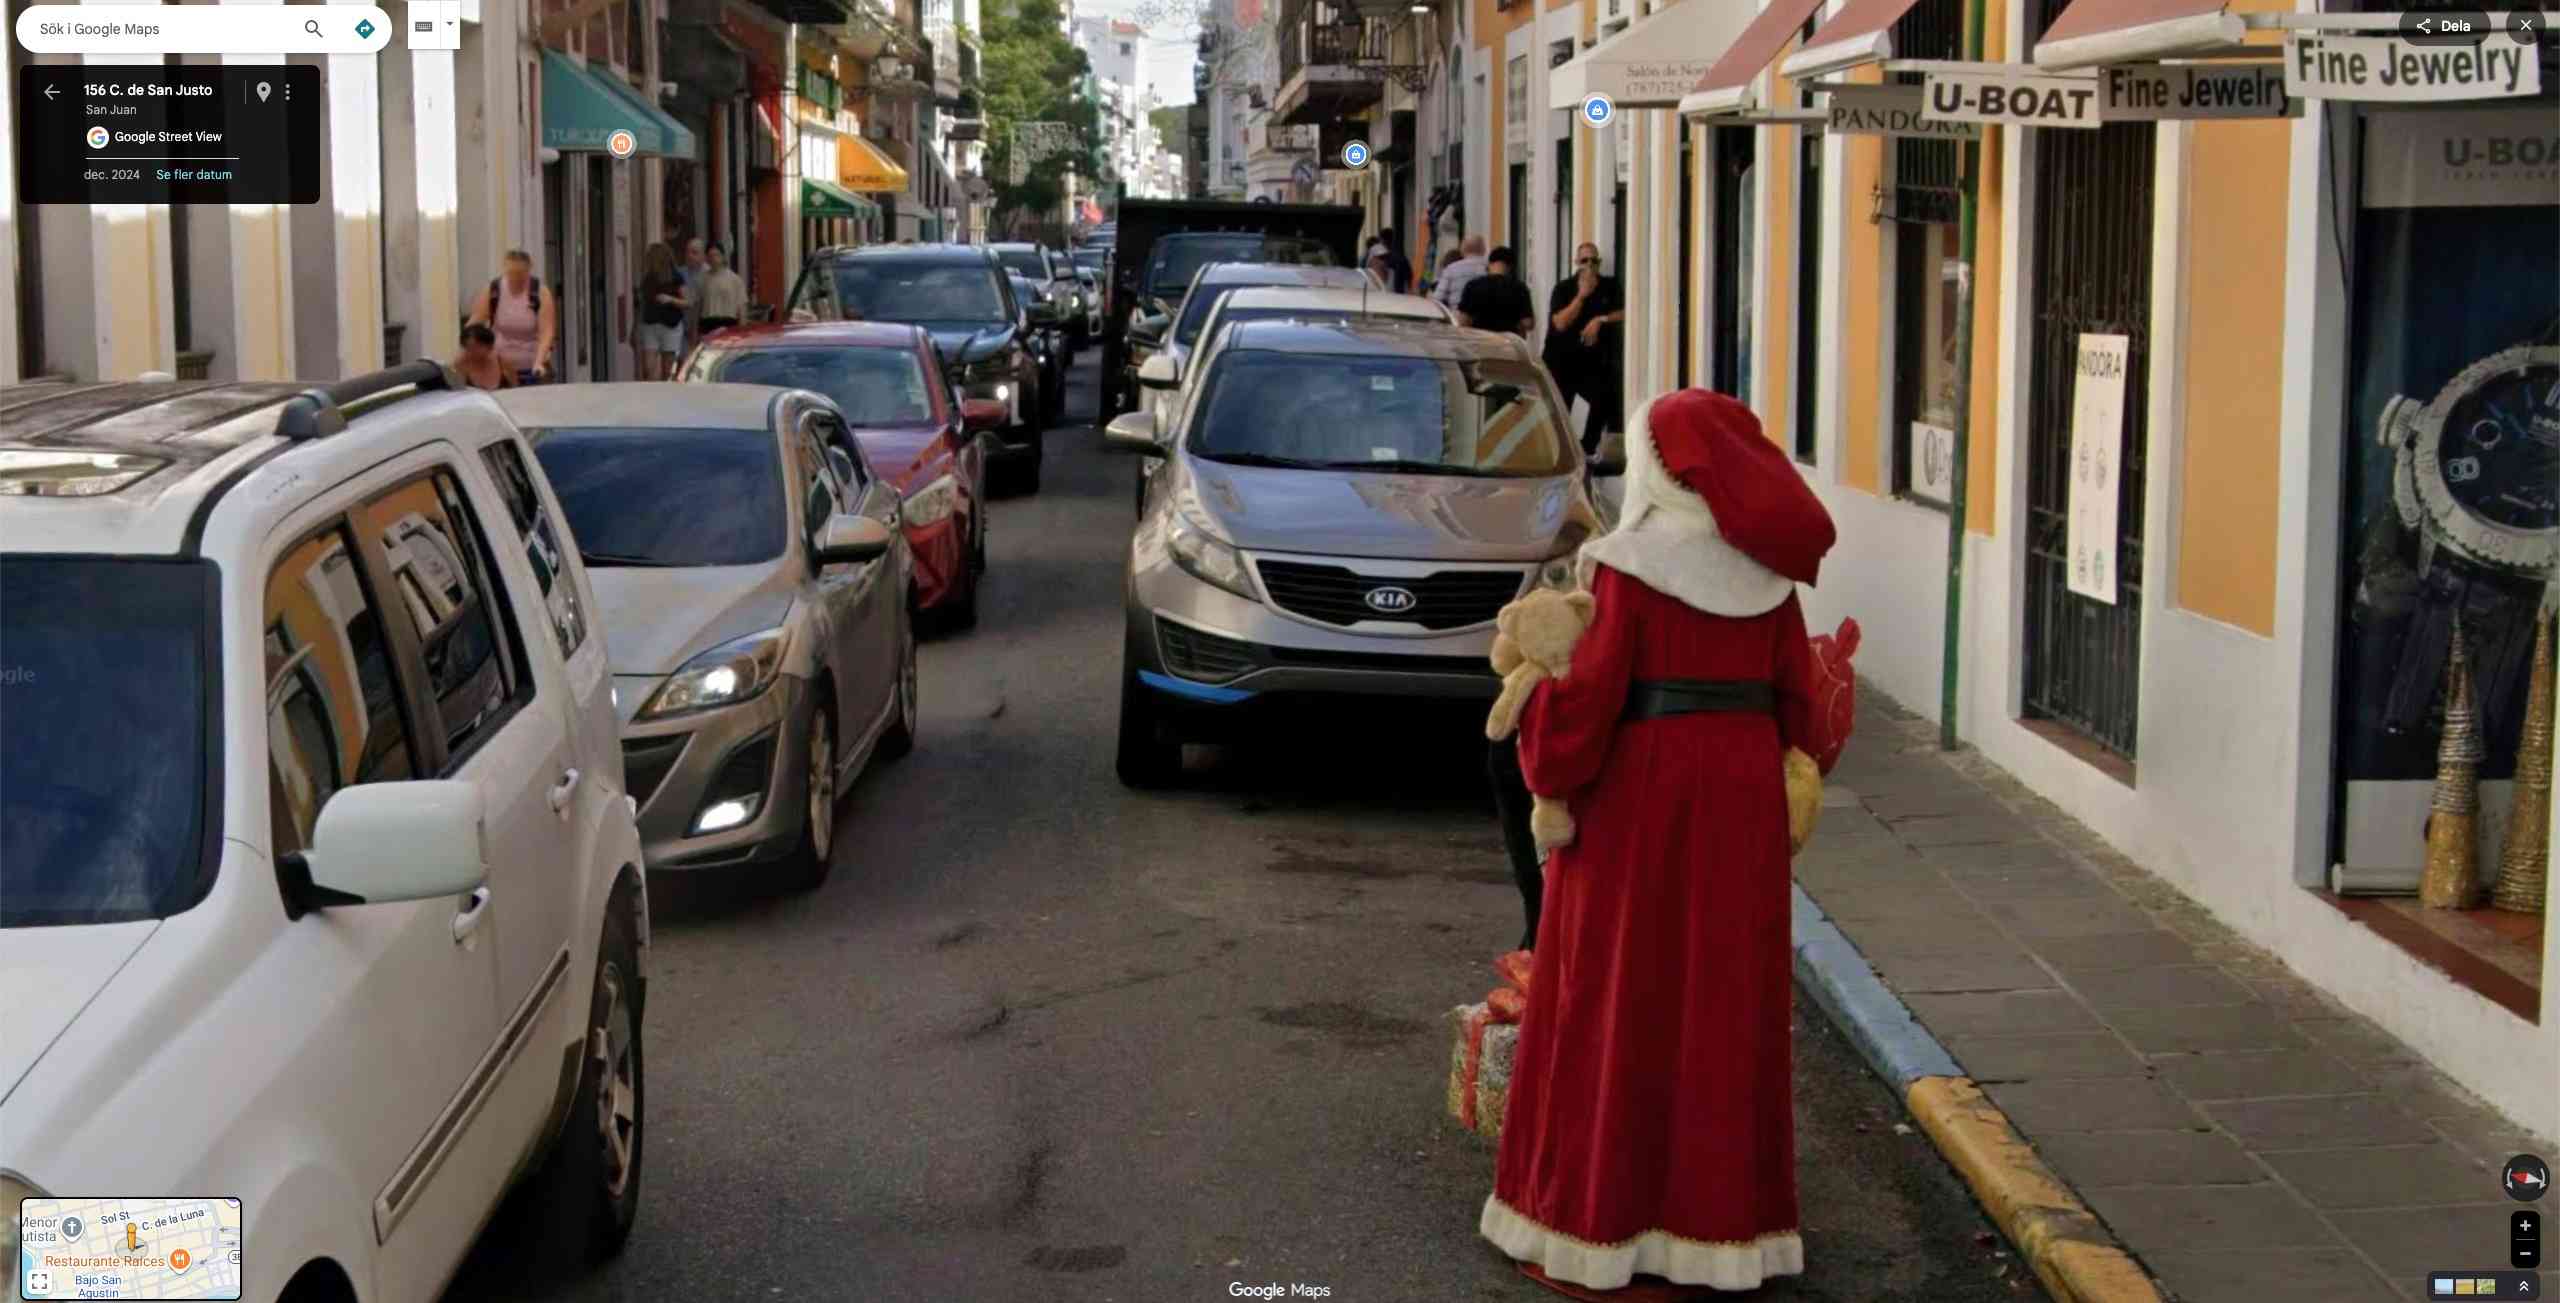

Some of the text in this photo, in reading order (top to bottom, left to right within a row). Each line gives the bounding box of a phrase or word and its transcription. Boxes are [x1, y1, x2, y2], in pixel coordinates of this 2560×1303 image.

[1662, 64, 1677, 76] de
[2297, 38, 2522, 92] Fine Jewelry
[1933, 83, 2094, 119] U-BOAT
[2109, 68, 2289, 116] Fine Jewelry
[1374, 592, 1408, 606] KIA
